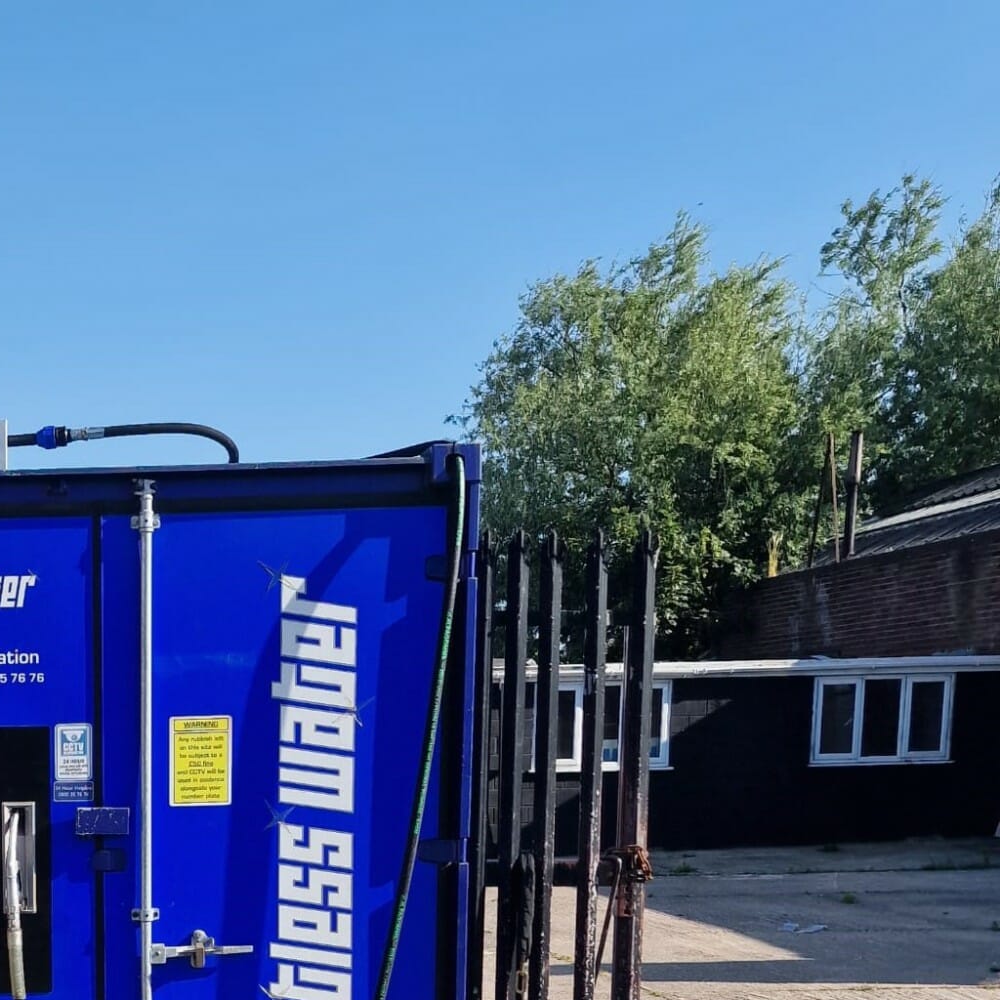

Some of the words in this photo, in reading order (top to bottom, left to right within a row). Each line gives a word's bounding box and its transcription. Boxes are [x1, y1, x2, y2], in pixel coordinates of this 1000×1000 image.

[10, 672, 26, 684] 76
[29, 672, 45, 684] 76
[271, 573, 358, 813] water
[183, 721, 219, 729] WARNING
[63, 742, 84, 752] CCTV
